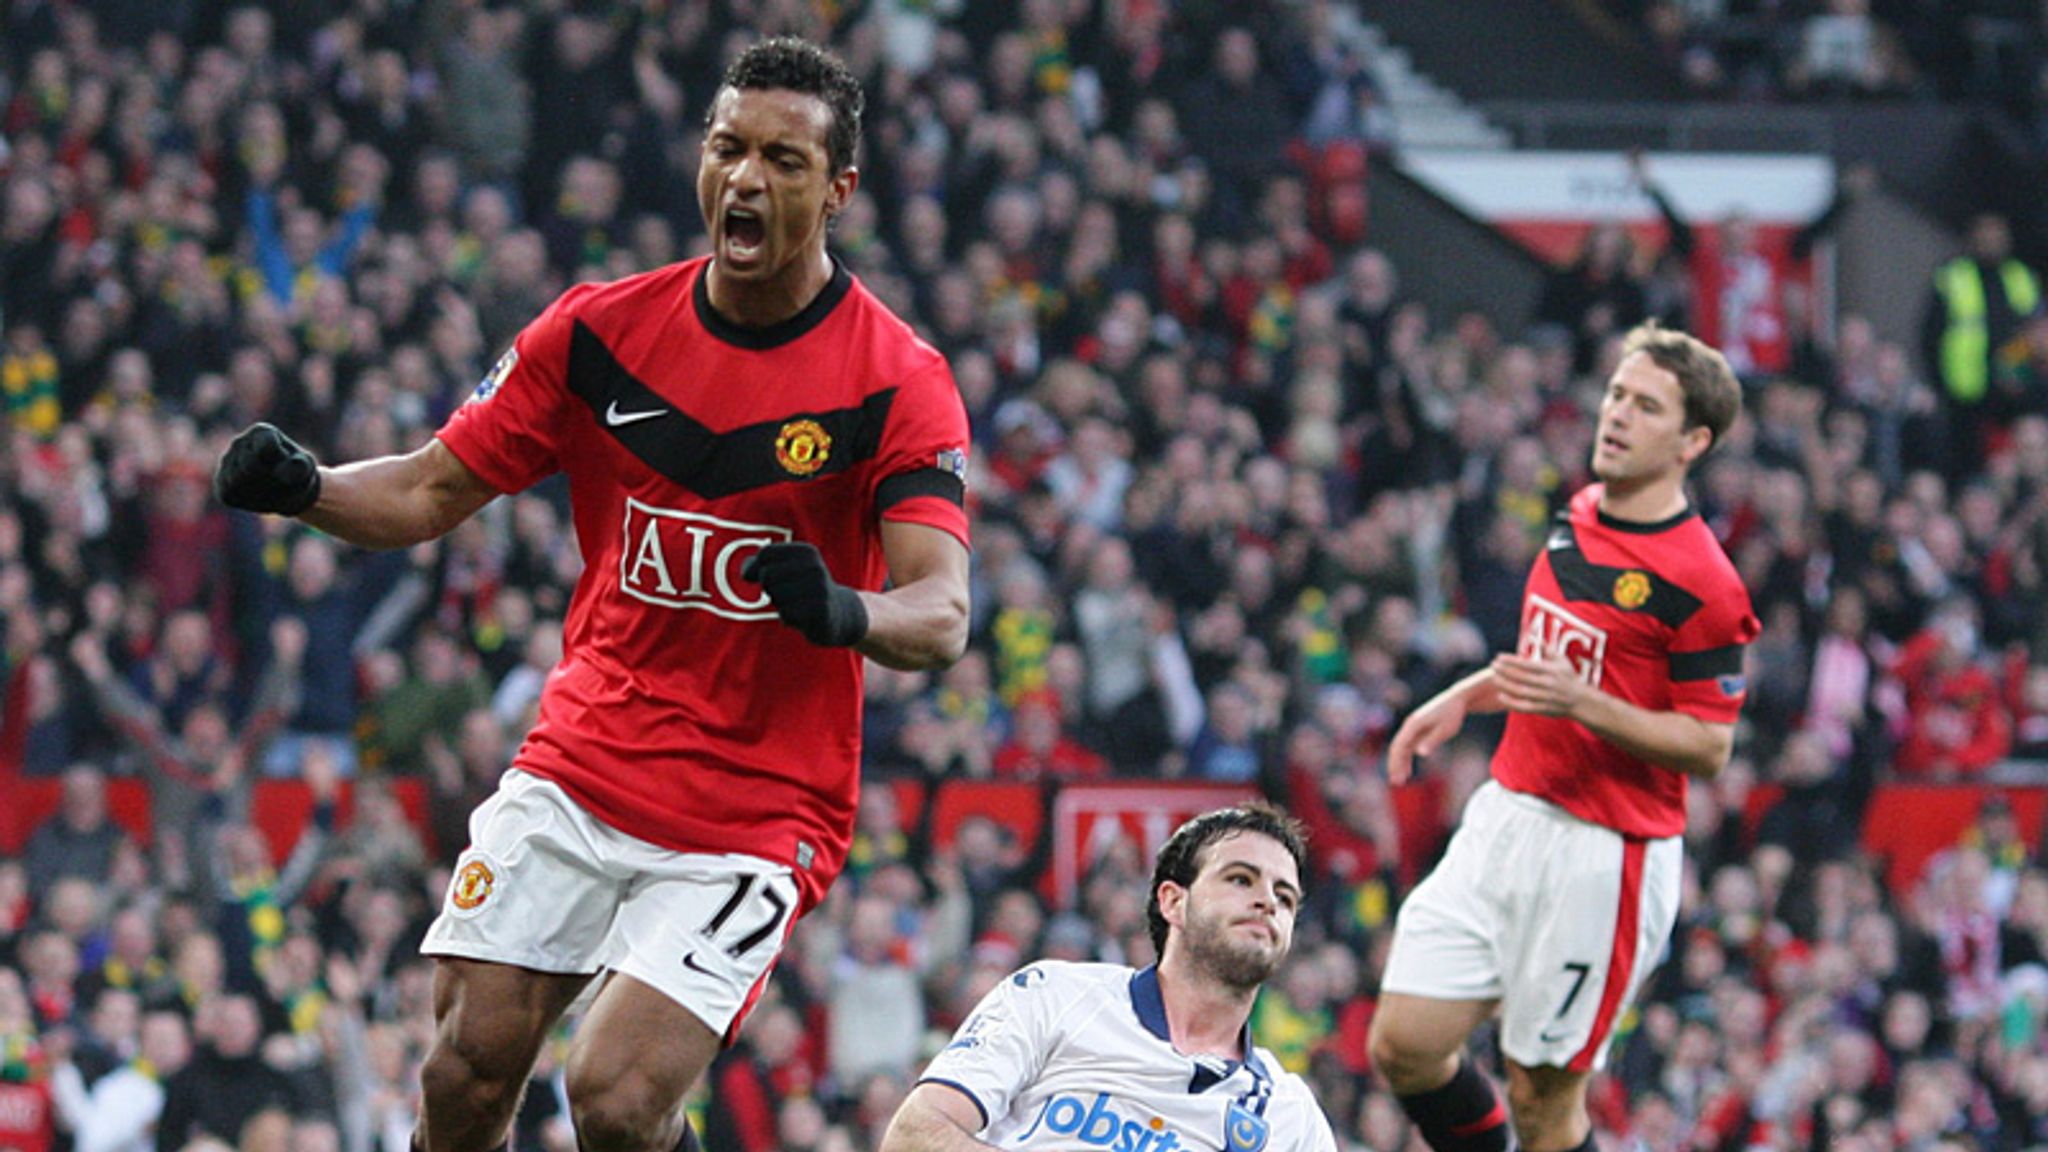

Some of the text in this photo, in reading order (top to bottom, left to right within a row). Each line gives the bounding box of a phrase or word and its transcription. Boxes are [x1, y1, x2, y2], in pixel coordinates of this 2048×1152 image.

[700, 873, 787, 959] 17
[1555, 962, 1591, 1019] 7
[1018, 1091, 1193, 1152] jobsit
